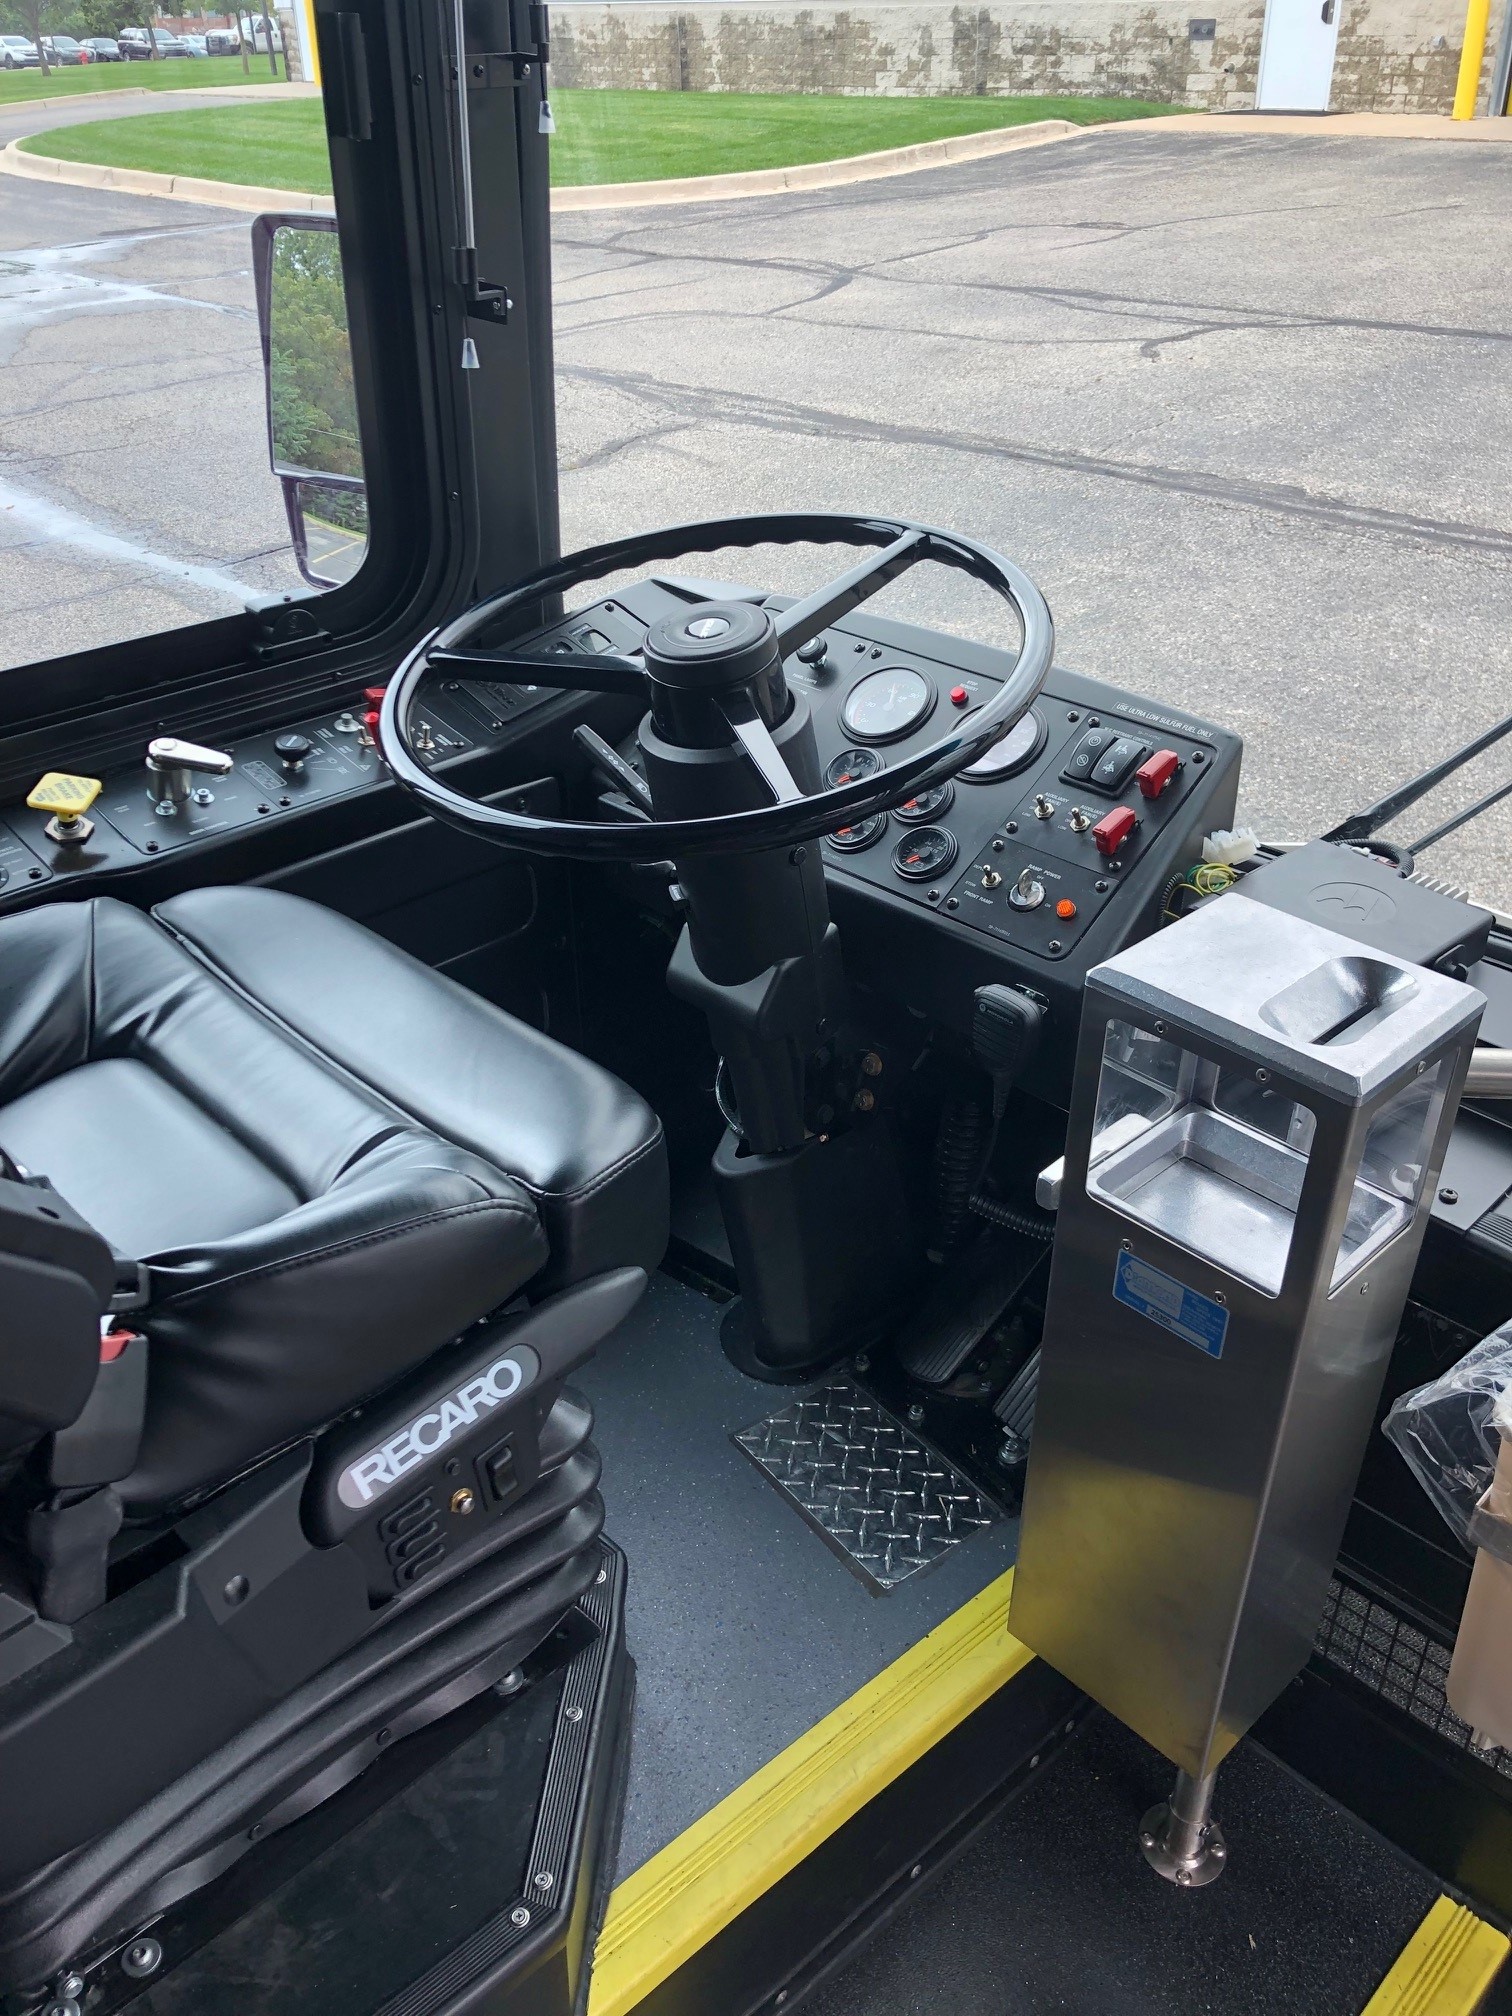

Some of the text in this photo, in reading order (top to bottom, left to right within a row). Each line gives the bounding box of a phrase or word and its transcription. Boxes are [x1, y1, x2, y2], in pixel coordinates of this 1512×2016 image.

[1116, 702, 1215, 738] USE ULTRA LOW SULFUR FUEL ONLY
[1044, 791, 1070, 803] AUXILIARY
[1079, 804, 1106, 816] AUXILIARY
[1027, 863, 1062, 880] RAMP POWER
[963, 889, 994, 906] FRONT RAMP
[986, 1009, 1014, 1025] MOTOROLA
[350, 1359, 522, 1500] RECARO
